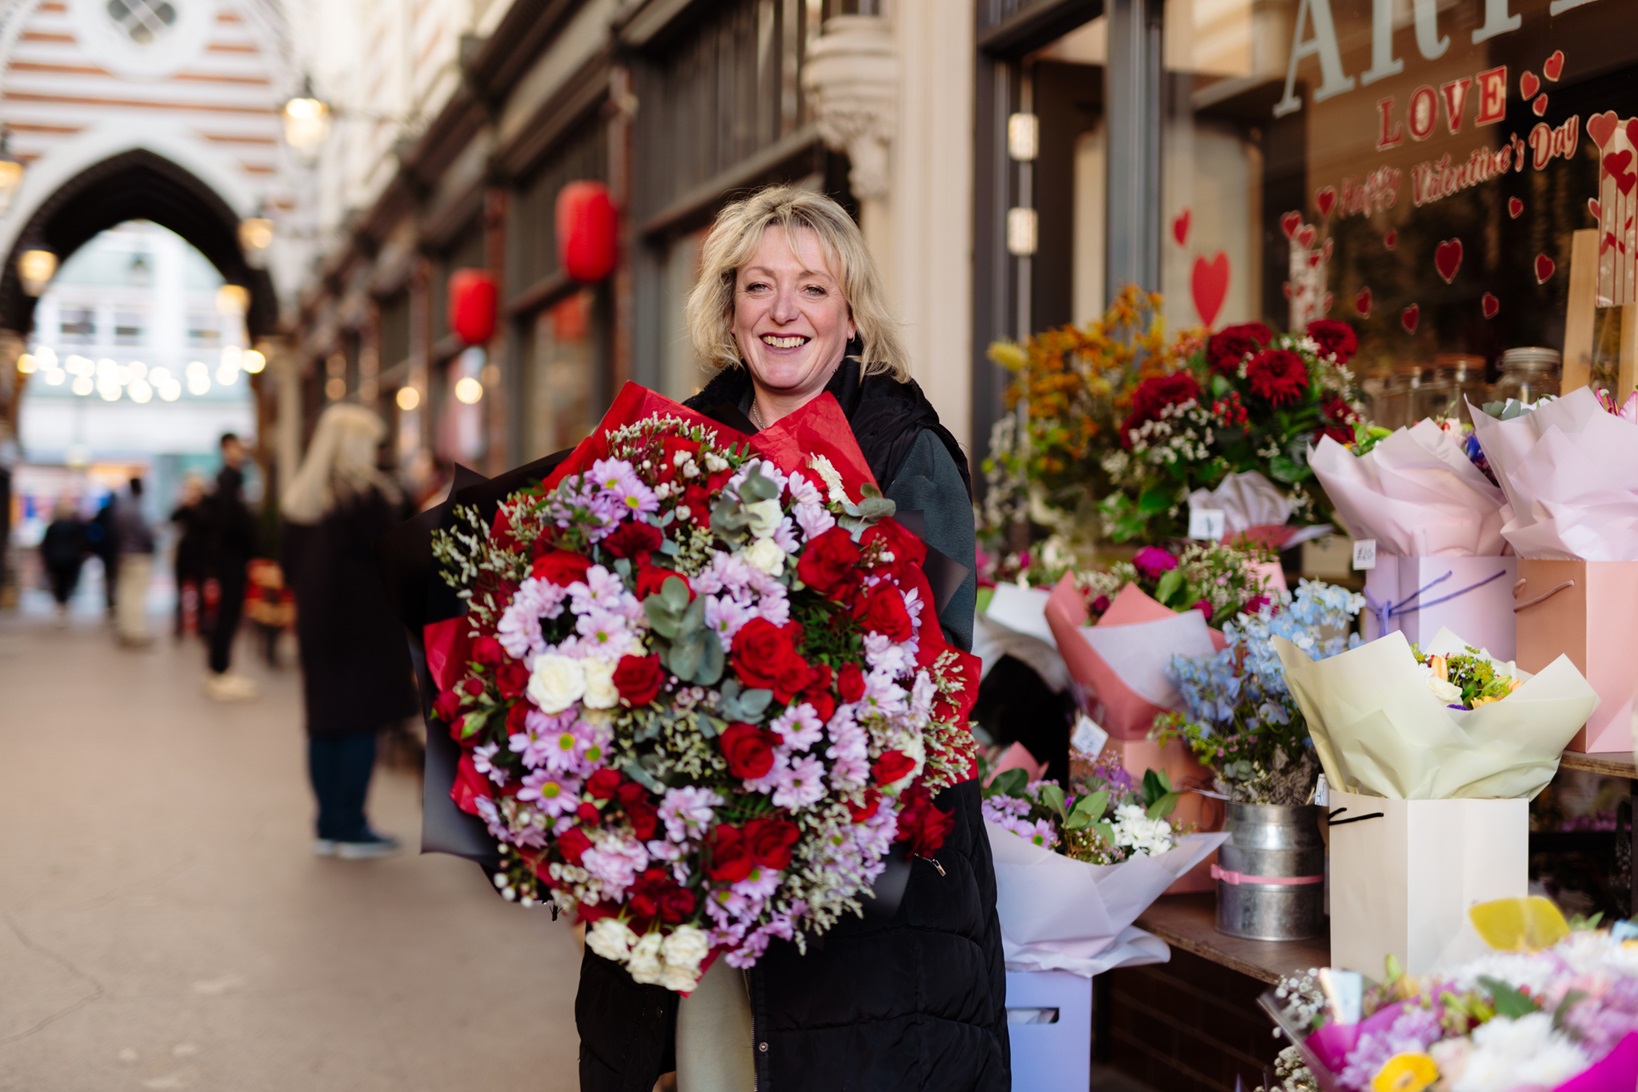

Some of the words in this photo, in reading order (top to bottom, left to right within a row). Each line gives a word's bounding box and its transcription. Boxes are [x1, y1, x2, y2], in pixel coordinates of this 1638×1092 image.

[1377, 65, 1508, 152] LOVE
[1411, 132, 1525, 207] Valentine's
[1528, 114, 1580, 171] Day
